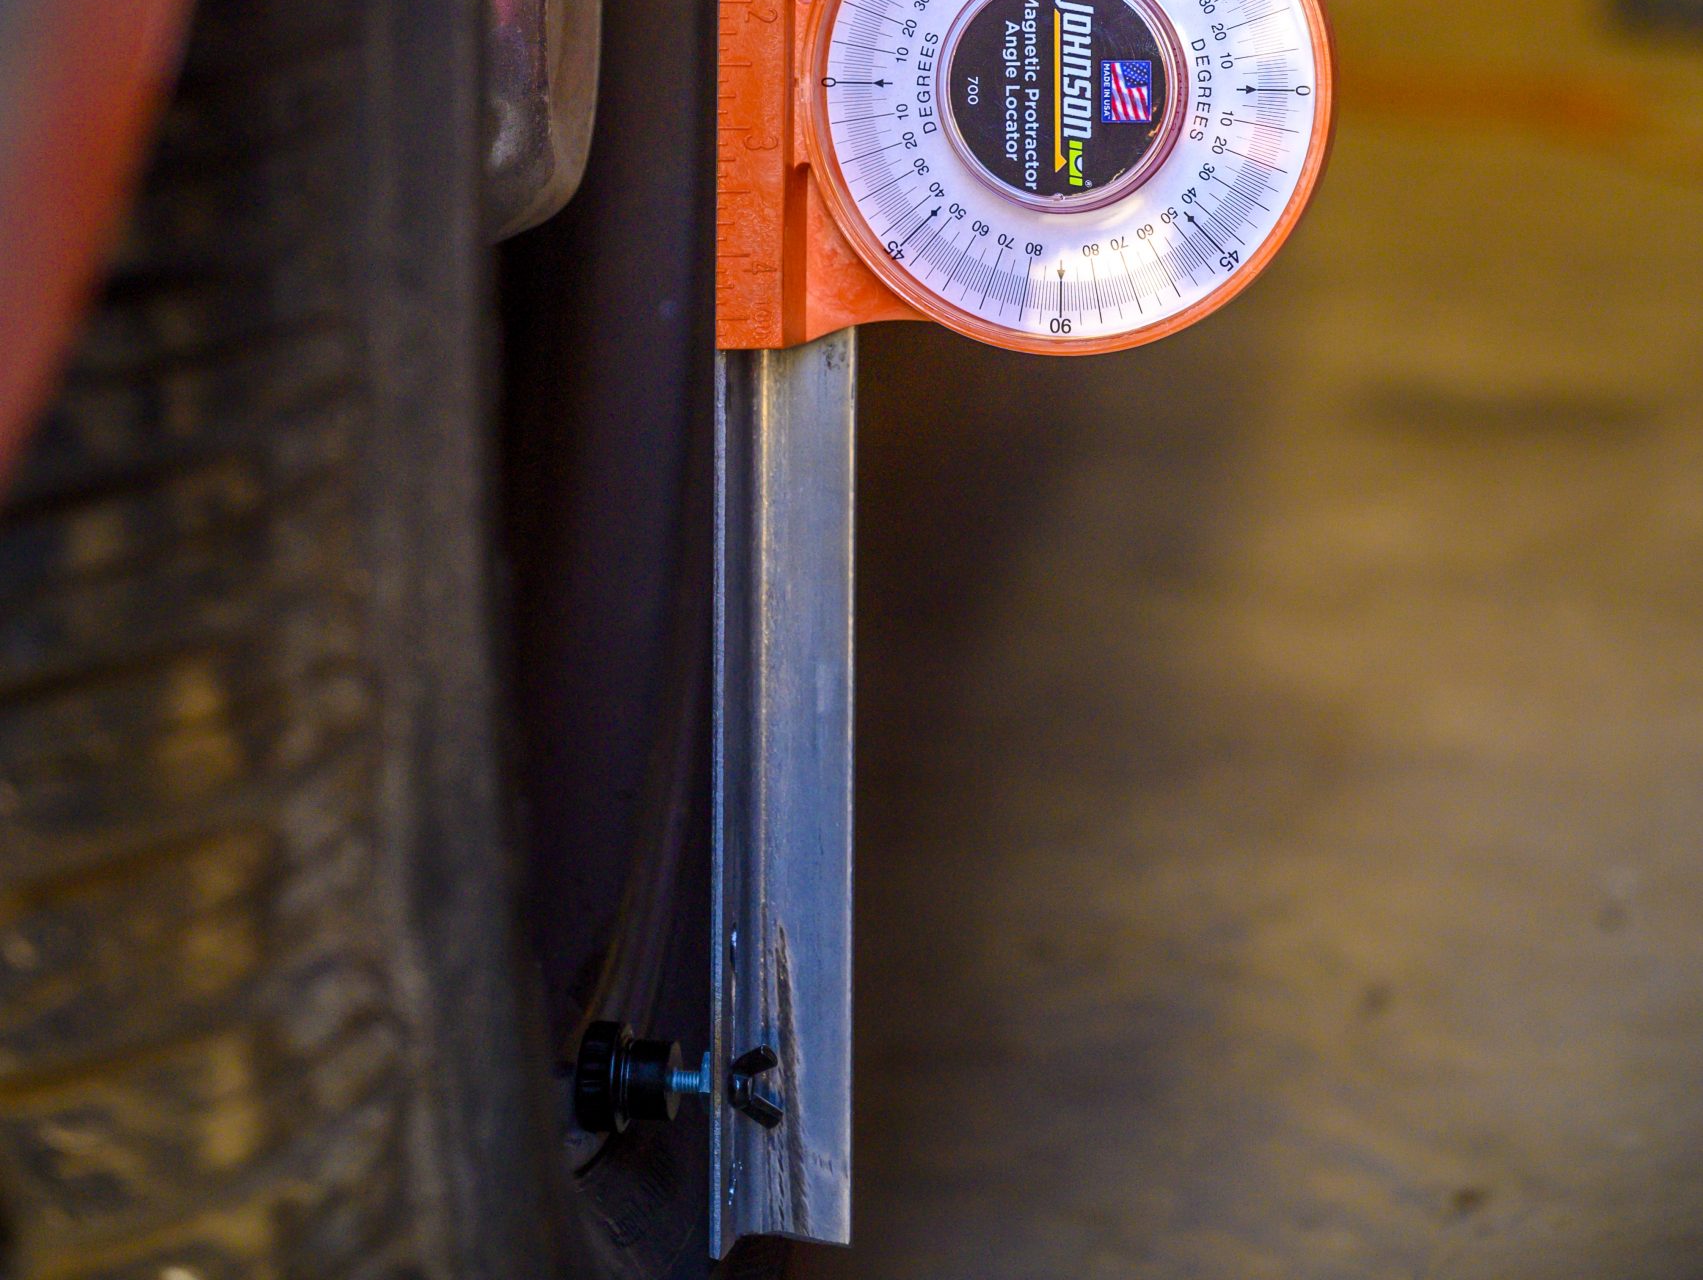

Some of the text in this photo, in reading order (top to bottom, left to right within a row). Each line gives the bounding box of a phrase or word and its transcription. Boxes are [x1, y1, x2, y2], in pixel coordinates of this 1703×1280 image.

[902, 19, 918, 38] 20
[1211, 22, 1227, 41] 20
[896, 47, 909, 63] 10
[1220, 52, 1233, 69] 10
[821, 77, 836, 87] 0
[917, 32, 939, 134] DEGREES
[1103, 63, 1111, 87] MADE
[966, 76, 979, 106] 700
[1002, 20, 1020, 162] Angle Locator
[1103, 89, 1111, 98] IN
[1190, 39, 1212, 141] DEGREES
[1294, 85, 1311, 96] 0
[896, 103, 909, 120] 10
[1220, 110, 1234, 127] 10
[902, 131, 918, 150] 20
[1024, 88, 1040, 190] Protractor
[1211, 136, 1228, 155] 20
[913, 157, 930, 176] 30
[1198, 162, 1216, 181] 30
[929, 181, 945, 199] 40
[1181, 186, 1198, 204] 40
[948, 202, 967, 221] 50
[1160, 206, 1179, 224] 50
[971, 220, 990, 237] 60
[1136, 223, 1154, 241] 60
[997, 233, 1016, 249] 70
[1025, 242, 1043, 257] 80
[1110, 235, 1129, 251] 70
[883, 240, 905, 261] 45
[1082, 243, 1100, 258] 80
[1219, 249, 1240, 272] 45
[1049, 318, 1072, 334] 90
